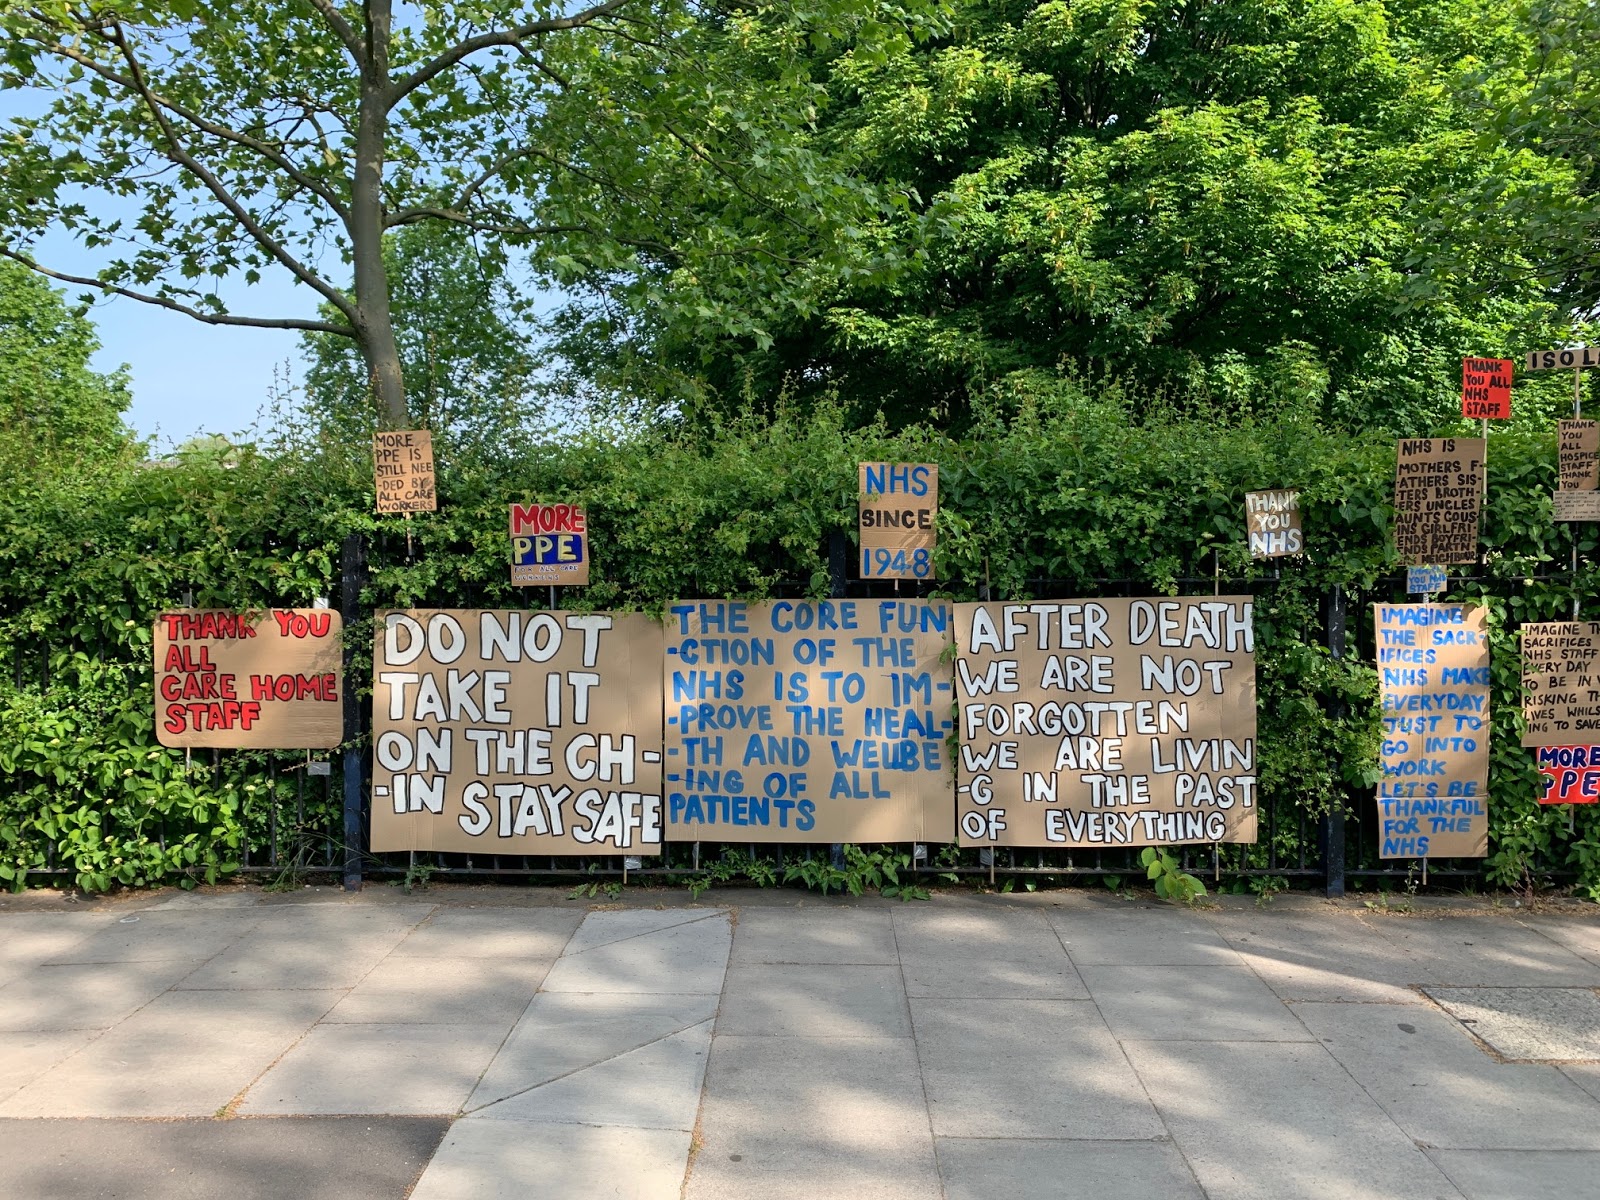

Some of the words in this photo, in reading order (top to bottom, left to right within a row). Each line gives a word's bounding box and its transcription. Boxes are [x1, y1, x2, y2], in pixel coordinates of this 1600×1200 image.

[1466, 360, 1502, 373] THANK
[1532, 350, 1600, 368] ISOL
[1466, 374, 1485, 386] YOU
[1489, 375, 1510, 388] ALL
[1465, 387, 1489, 401] NHS
[1466, 401, 1500, 416] STAFF
[1561, 421, 1595, 430] THANK
[375, 434, 414, 448] MORE
[1562, 431, 1582, 440] YOU
[376, 449, 400, 463] PPE
[409, 448, 421, 461] IS
[1402, 439, 1432, 456] NHS
[1442, 439, 1455, 452] IS
[1561, 442, 1581, 450] ALL
[1560, 452, 1599, 462] HOSPICE
[1561, 461, 1593, 472] STAFF
[376, 464, 407, 477] STILL
[411, 462, 433, 474] NEE
[1399, 460, 1461, 475] MOTHERS
[1560, 471, 1592, 479] THANK
[411, 477, 426, 488] BY
[866, 465, 930, 496] NHS
[379, 491, 401, 502] ALL
[405, 489, 433, 500] CARE
[1245, 491, 1300, 513] THANK
[1426, 498, 1475, 511] UNCLES
[379, 501, 433, 511] WORKERS
[513, 503, 585, 535] MORE
[862, 509, 931, 529] SINCE
[1255, 513, 1290, 532] YOU
[1395, 511, 1441, 524] AUNTS
[513, 535, 576, 564] PPE
[1251, 528, 1301, 556] NHS
[864, 548, 930, 578] 1948
[1409, 576, 1426, 584] YOU
[1409, 583, 1441, 592] STAFF
[161, 611, 256, 640] THANK
[273, 610, 331, 638] YOU
[670, 603, 749, 635] THE
[771, 601, 858, 633] CORE
[1381, 607, 1463, 626] IMAGINE
[969, 602, 1113, 655] AFTER
[1129, 600, 1254, 653] DEATH
[1525, 624, 1580, 636] IMAGINE
[384, 612, 466, 666] DO
[480, 611, 612, 667] NOT
[1380, 629, 1416, 646] THE
[1524, 637, 1591, 648] SACRIFICES
[165, 644, 216, 672] ALL
[793, 638, 836, 667] OF
[852, 637, 916, 668] THE
[1380, 647, 1437, 664] IFICES
[1524, 649, 1552, 660] NHS
[1561, 649, 1599, 659] STAFF
[957, 657, 1020, 698] WE
[1040, 654, 1114, 693] ARE
[1140, 654, 1233, 696] NOT
[1566, 661, 1591, 673] DAY
[160, 673, 237, 701] CARE
[250, 673, 338, 701] HOME
[672, 669, 745, 702] NHS
[774, 671, 809, 703] IS
[820, 671, 865, 704] TO
[1383, 667, 1428, 688] NHS
[1441, 667, 1490, 686] MAKE
[1523, 679, 1538, 690] TO
[1549, 676, 1567, 688] BE
[1578, 675, 1591, 687] IN
[379, 669, 513, 725] TAKE
[546, 671, 600, 727] IT
[1382, 693, 1485, 712] EVERYDAY
[1524, 693, 1577, 708] RISKING
[164, 701, 261, 734] STAFF
[786, 705, 844, 736] THE
[965, 700, 1189, 740] FORGOTTEN
[1525, 708, 1555, 721] LIVES
[1383, 715, 1443, 735] JUST
[1454, 714, 1483, 732] TO
[1554, 720, 1569, 730] TO
[376, 727, 452, 774] ON
[465, 729, 553, 776] THE
[743, 733, 810, 767] AND
[961, 741, 1018, 773] WE
[1054, 735, 1124, 772] ARE
[1151, 737, 1253, 774] LIVIN
[1381, 739, 1409, 757] GO
[1425, 737, 1477, 753] INTO
[1539, 745, 1600, 770] MORE
[1381, 759, 1447, 777] WORK
[763, 772, 807, 799] OF
[830, 771, 891, 800] ALL
[1023, 772, 1057, 802] IN
[1080, 773, 1150, 808] THE
[1175, 772, 1257, 810] PAST
[1381, 781, 1438, 798] LET'S
[1447, 781, 1478, 797] BE
[458, 781, 574, 838] STAY
[571, 788, 661, 848] SAFE
[669, 792, 816, 832] PATIENTS
[1379, 798, 1485, 816] THANKFUL
[961, 809, 1006, 841] OF
[1045, 808, 1226, 844] EVERYTHING
[1384, 817, 1420, 837] FOR
[1428, 816, 1472, 833] THE
[1383, 836, 1429, 856] NHS
